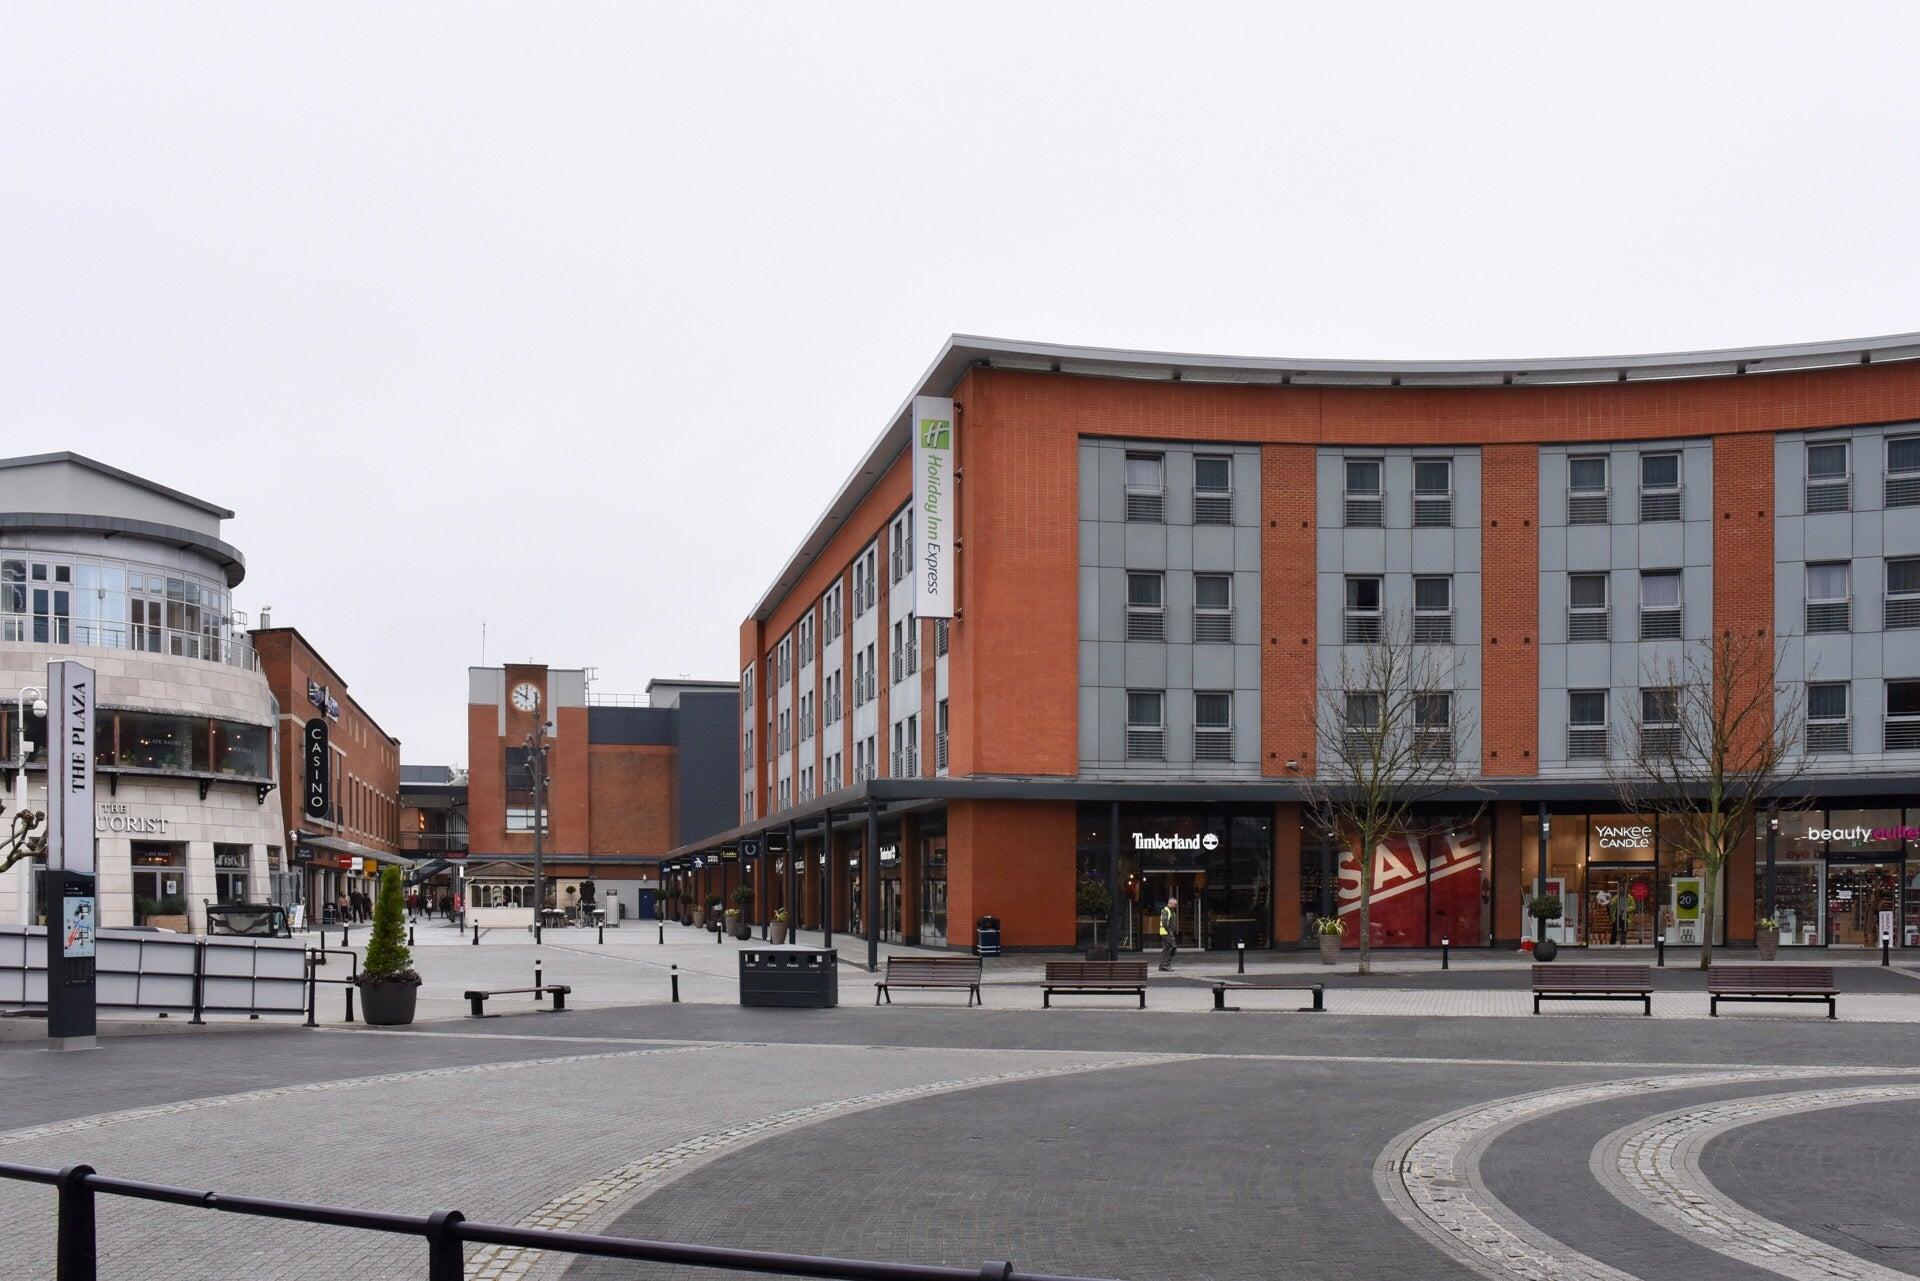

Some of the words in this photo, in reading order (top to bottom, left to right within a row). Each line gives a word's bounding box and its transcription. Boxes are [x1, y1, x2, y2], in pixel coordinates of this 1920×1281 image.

[924, 454, 943, 513] Holiday
[927, 516, 942, 540] Inn
[924, 542, 941, 595] Express
[72, 682, 85, 746] PLAZA
[72, 752, 85, 793] THE
[311, 728, 323, 807] CASINO
[103, 804, 126, 814] THE
[1132, 832, 1200, 850] Timberland
[1808, 826, 1872, 843] beauty
[1338, 830, 1481, 900] SALE
[1679, 895, 1692, 905] 20
